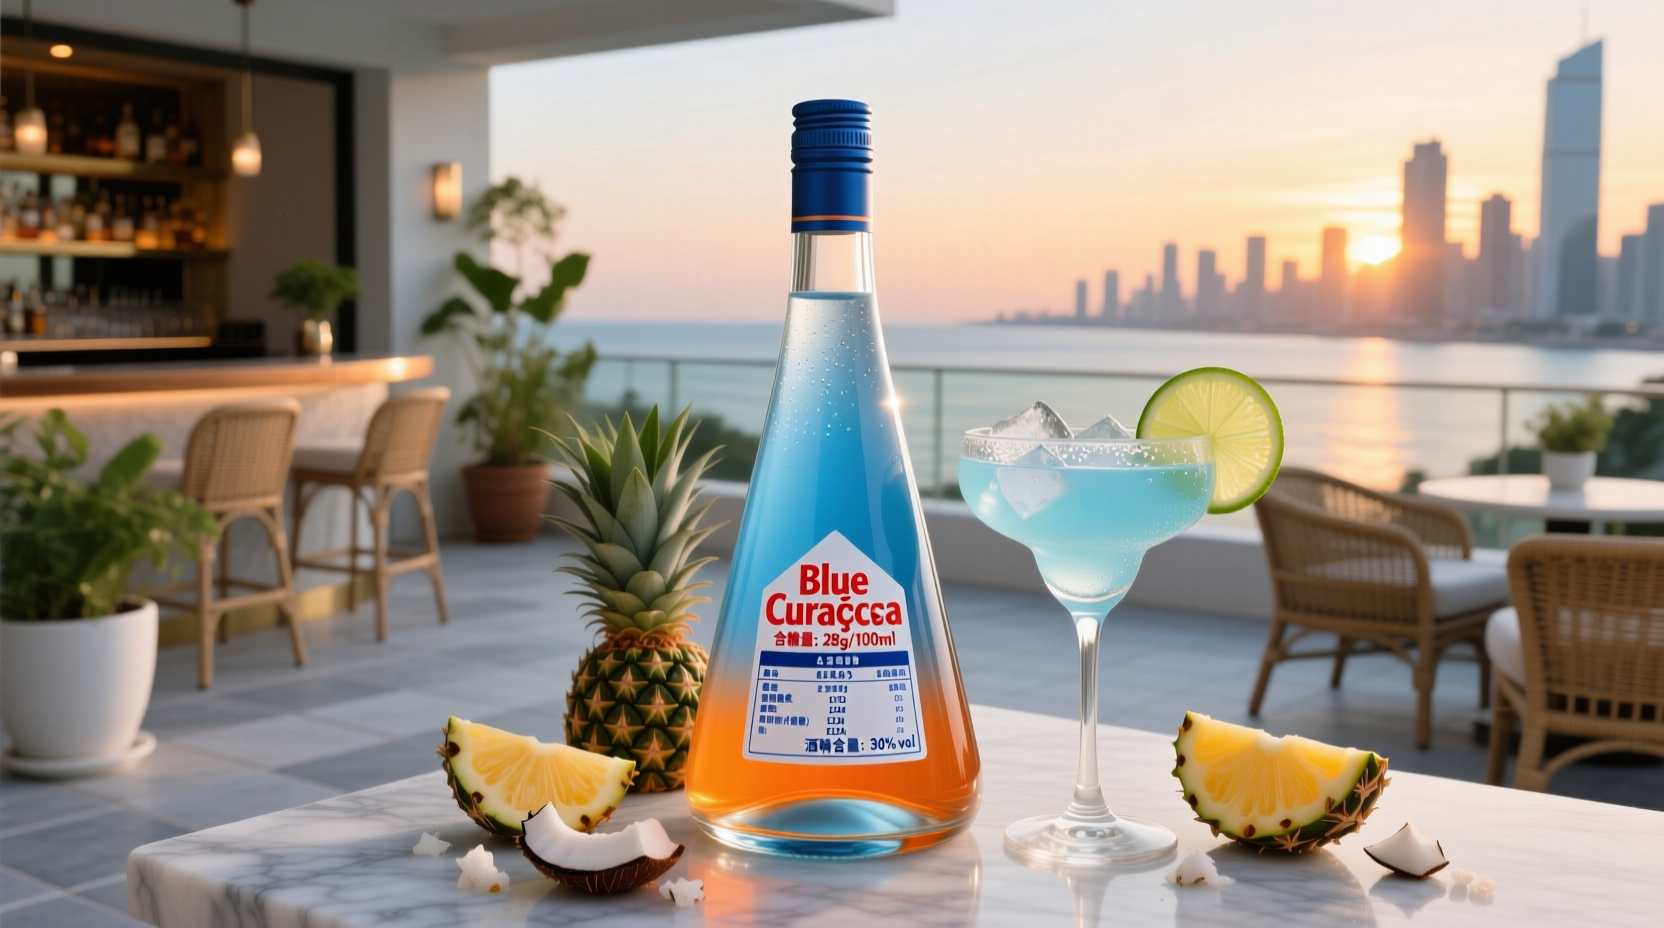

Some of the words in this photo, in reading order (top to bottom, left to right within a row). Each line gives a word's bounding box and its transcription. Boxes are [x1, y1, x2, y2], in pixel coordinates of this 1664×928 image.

[800, 563, 869, 595] Blue
[870, 737, 897, 751] 30%
[898, 734, 916, 749] vol
